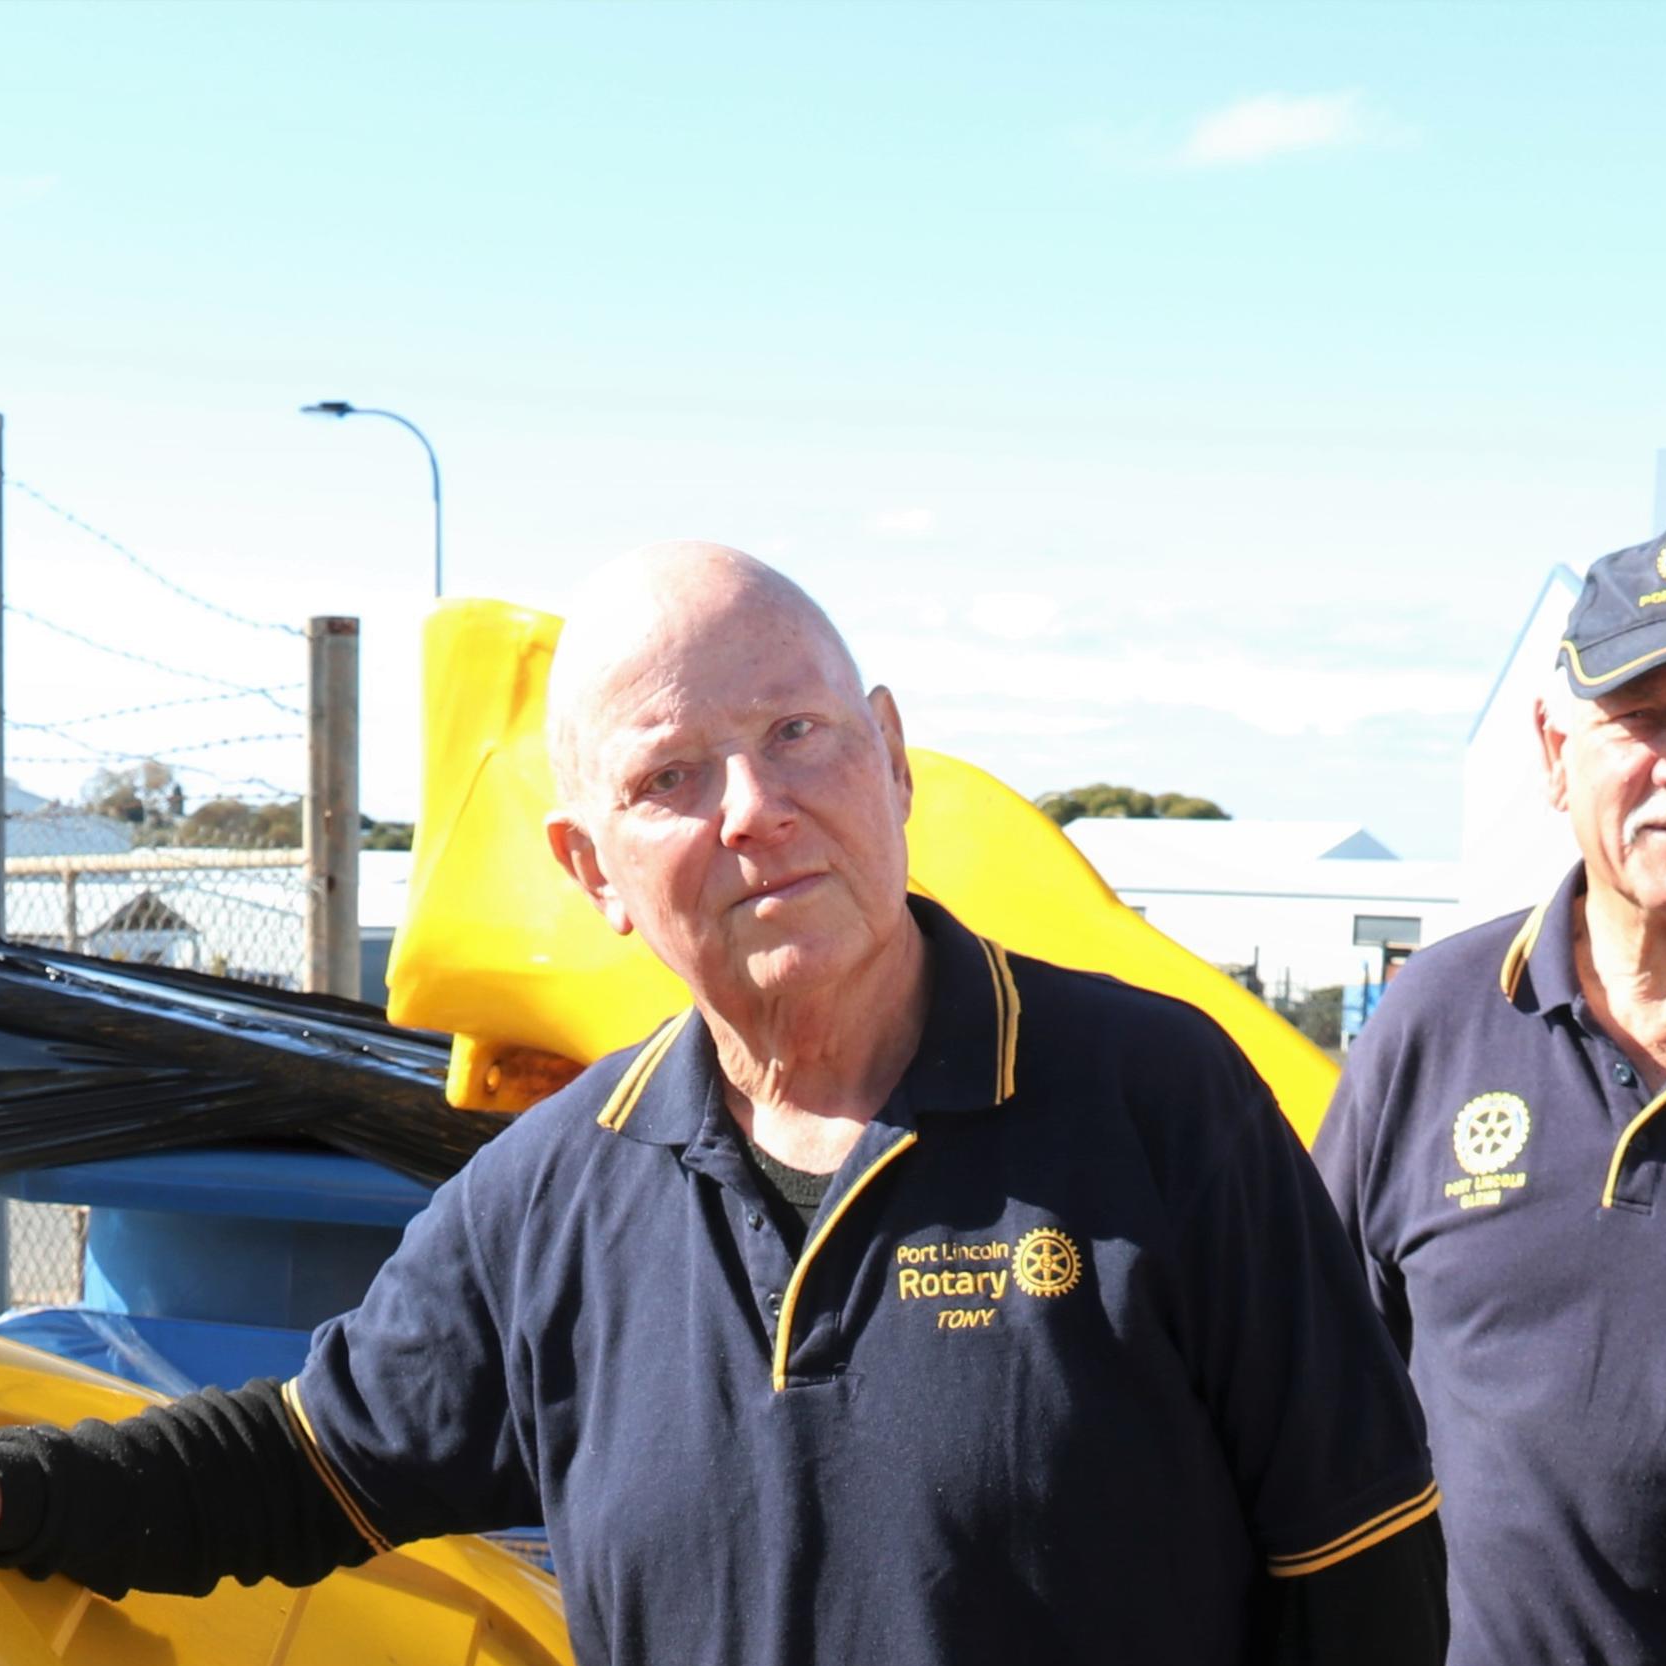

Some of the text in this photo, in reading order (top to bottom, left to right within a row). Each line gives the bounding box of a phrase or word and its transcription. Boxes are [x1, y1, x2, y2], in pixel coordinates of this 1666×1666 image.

[896, 1241, 1009, 1264] Port Lincoln
[898, 1269, 1008, 1300] Rotary
[937, 1308, 997, 1329] TONY
